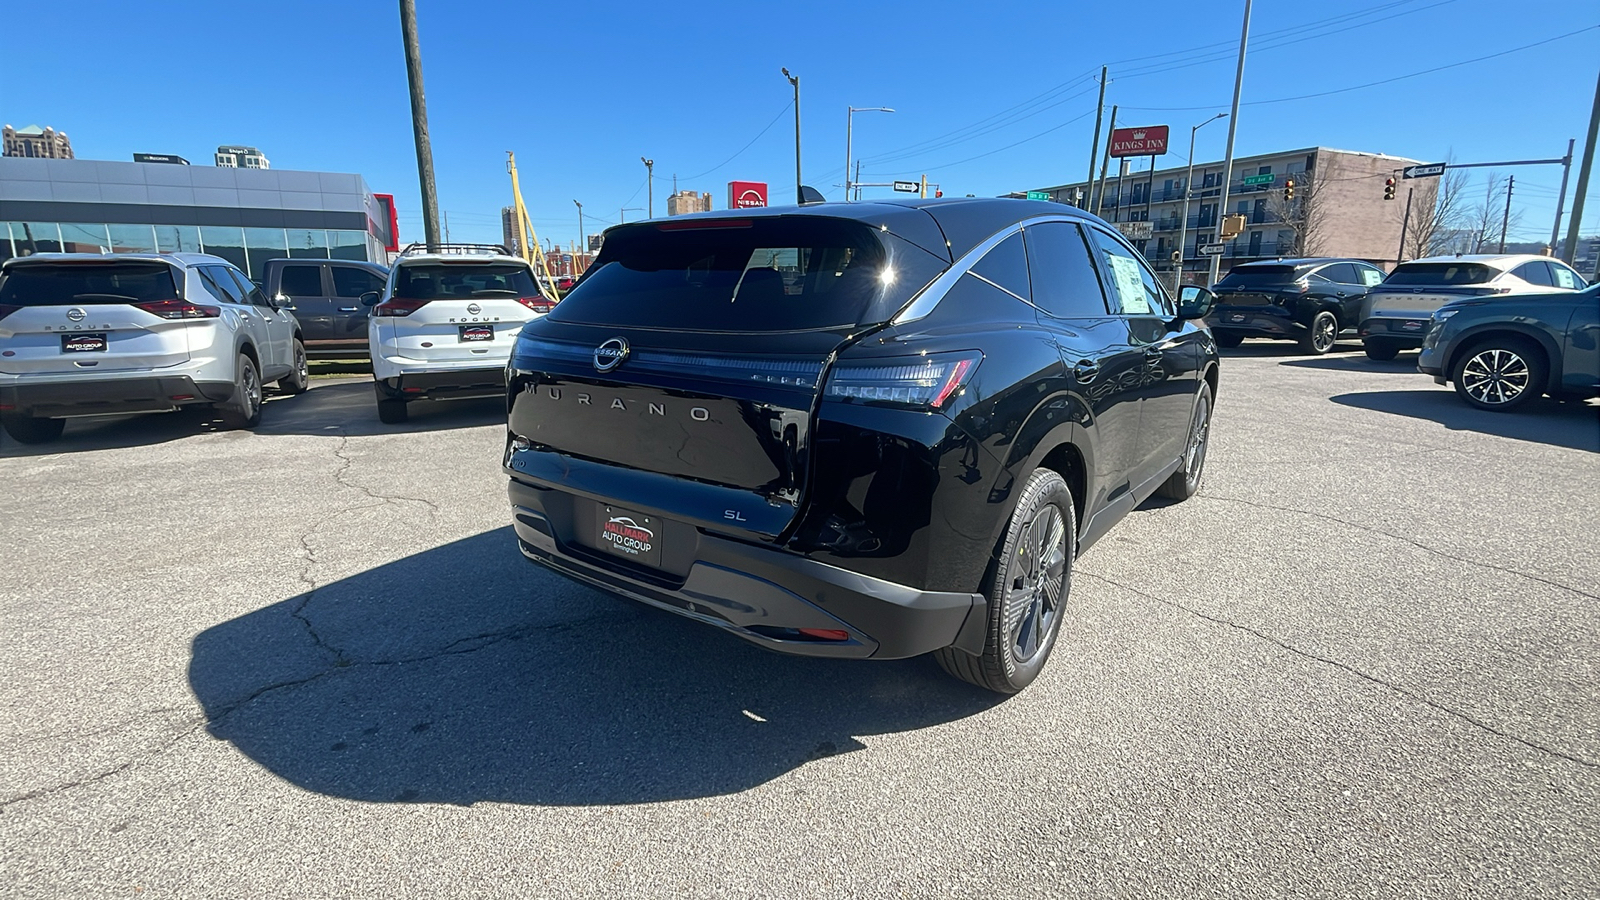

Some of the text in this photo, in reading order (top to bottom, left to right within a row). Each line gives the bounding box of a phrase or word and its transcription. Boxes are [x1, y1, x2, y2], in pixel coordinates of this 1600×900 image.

[1114, 139, 1164, 150] KINGS INN
[594, 348, 625, 357] NISSAN
[524, 383, 711, 421] MURANO
[723, 508, 747, 522] SL
[604, 522, 649, 542] HALLMARK
[601, 530, 652, 553] AUTO GROUP
[613, 542, 639, 555] Birmingham
[1002, 583, 1017, 678] BRIDGESTONE
